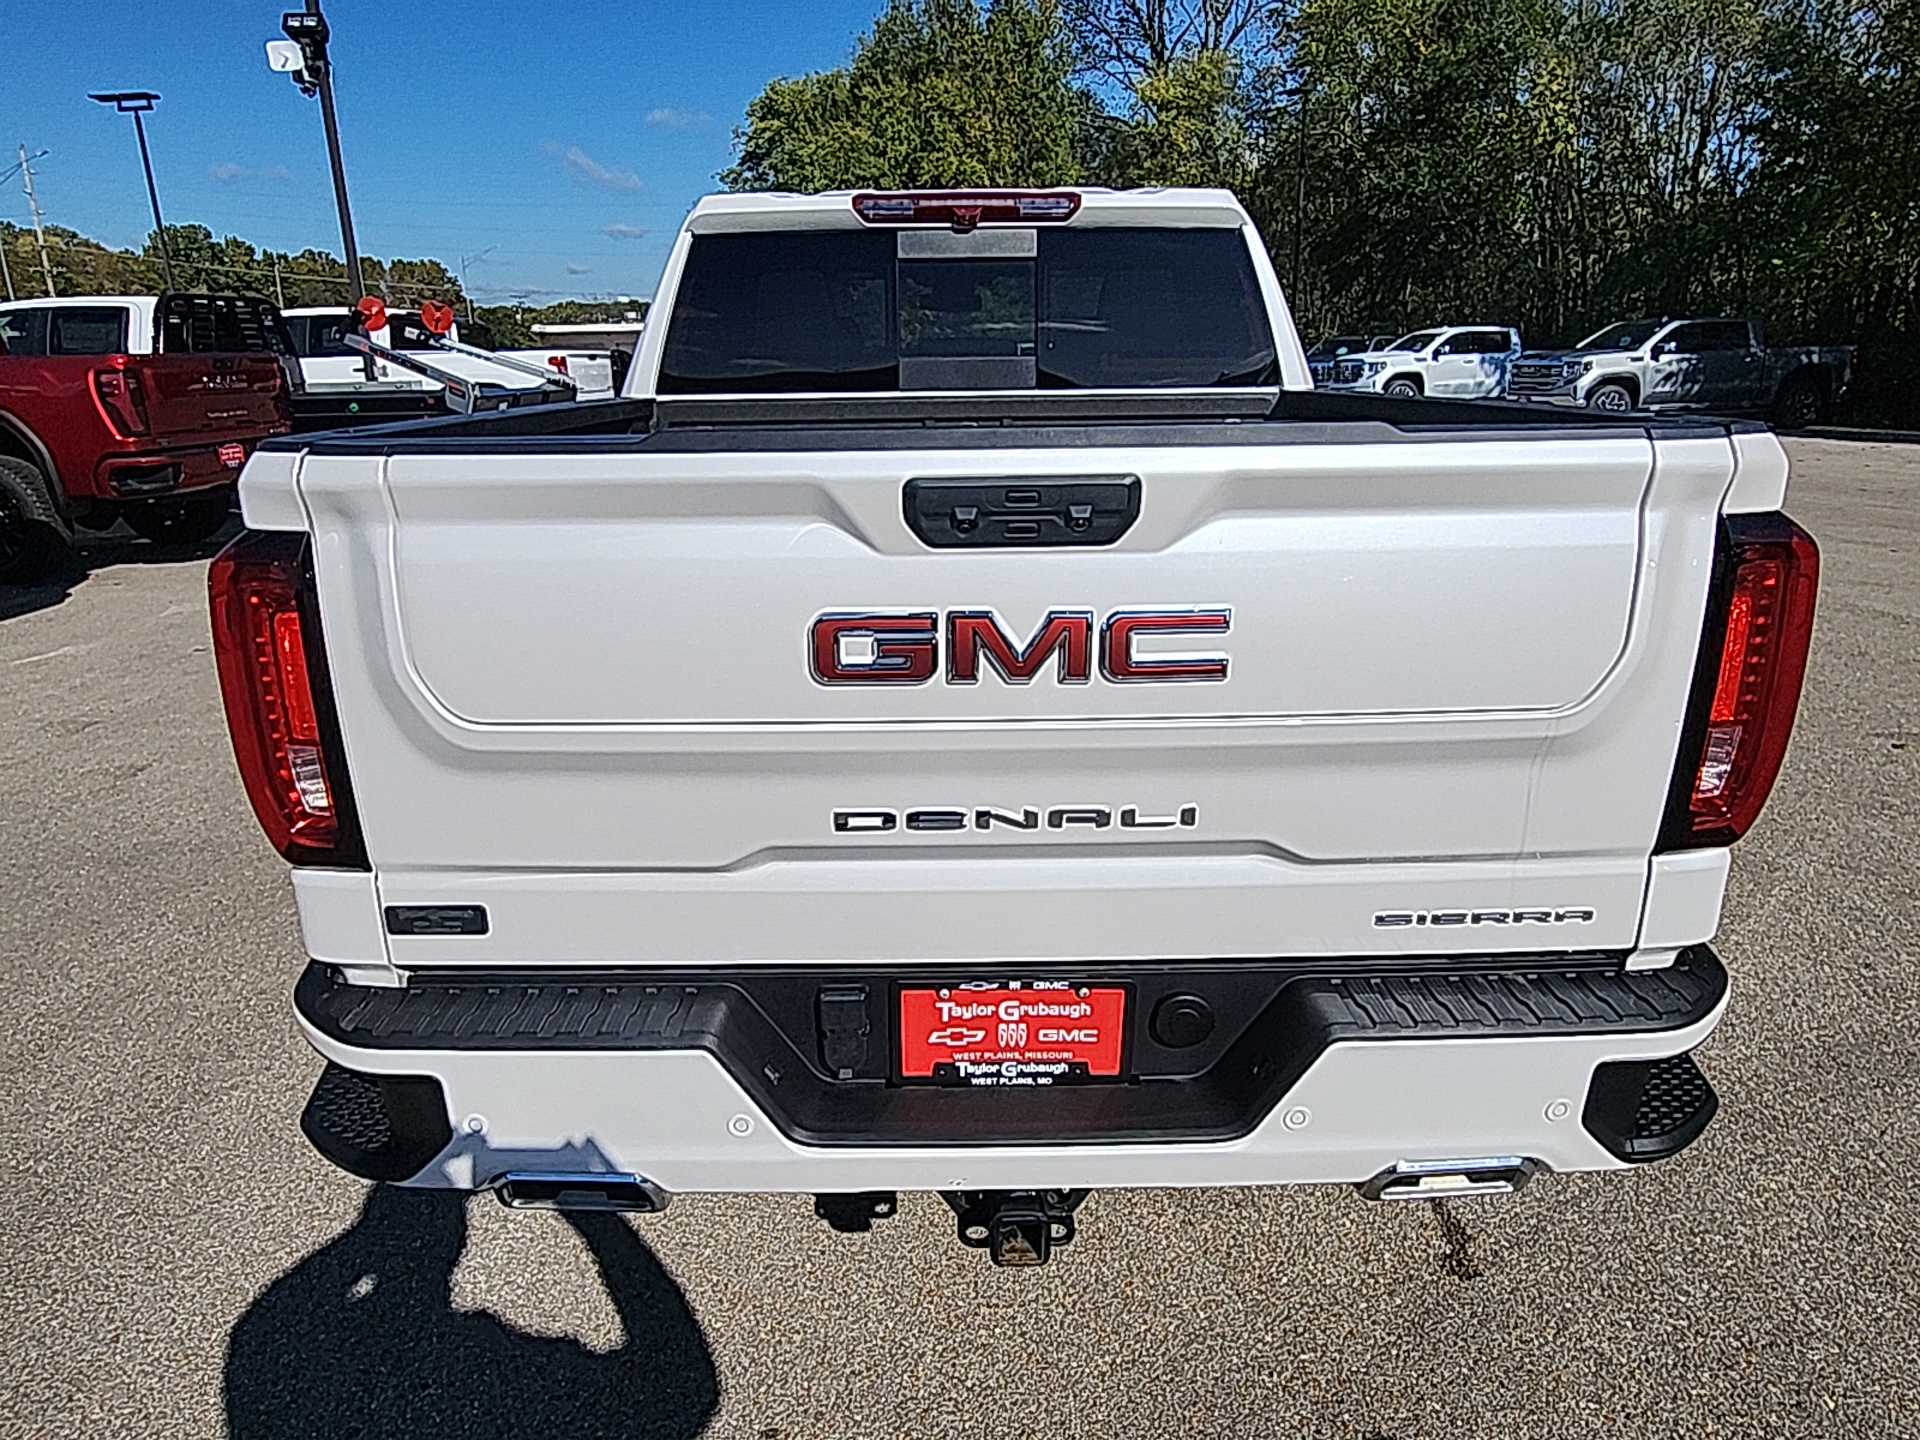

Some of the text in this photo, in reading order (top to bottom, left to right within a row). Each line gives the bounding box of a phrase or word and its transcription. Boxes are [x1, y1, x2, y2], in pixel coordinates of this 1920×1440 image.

[810, 608, 1231, 685] GMC
[834, 806, 1198, 831] DENALI
[1374, 910, 1595, 926] SIERRA
[1033, 981, 1069, 990] GMC
[935, 1001, 1091, 1022] Taylor Grubaugh
[1038, 1029, 1098, 1042] GMC
[953, 1052, 982, 1060] WEST
[1024, 1051, 1073, 1060] MISSOURI
[955, 1061, 1068, 1077] Taylor Grubaugh
[971, 1077, 998, 1085] WEST
